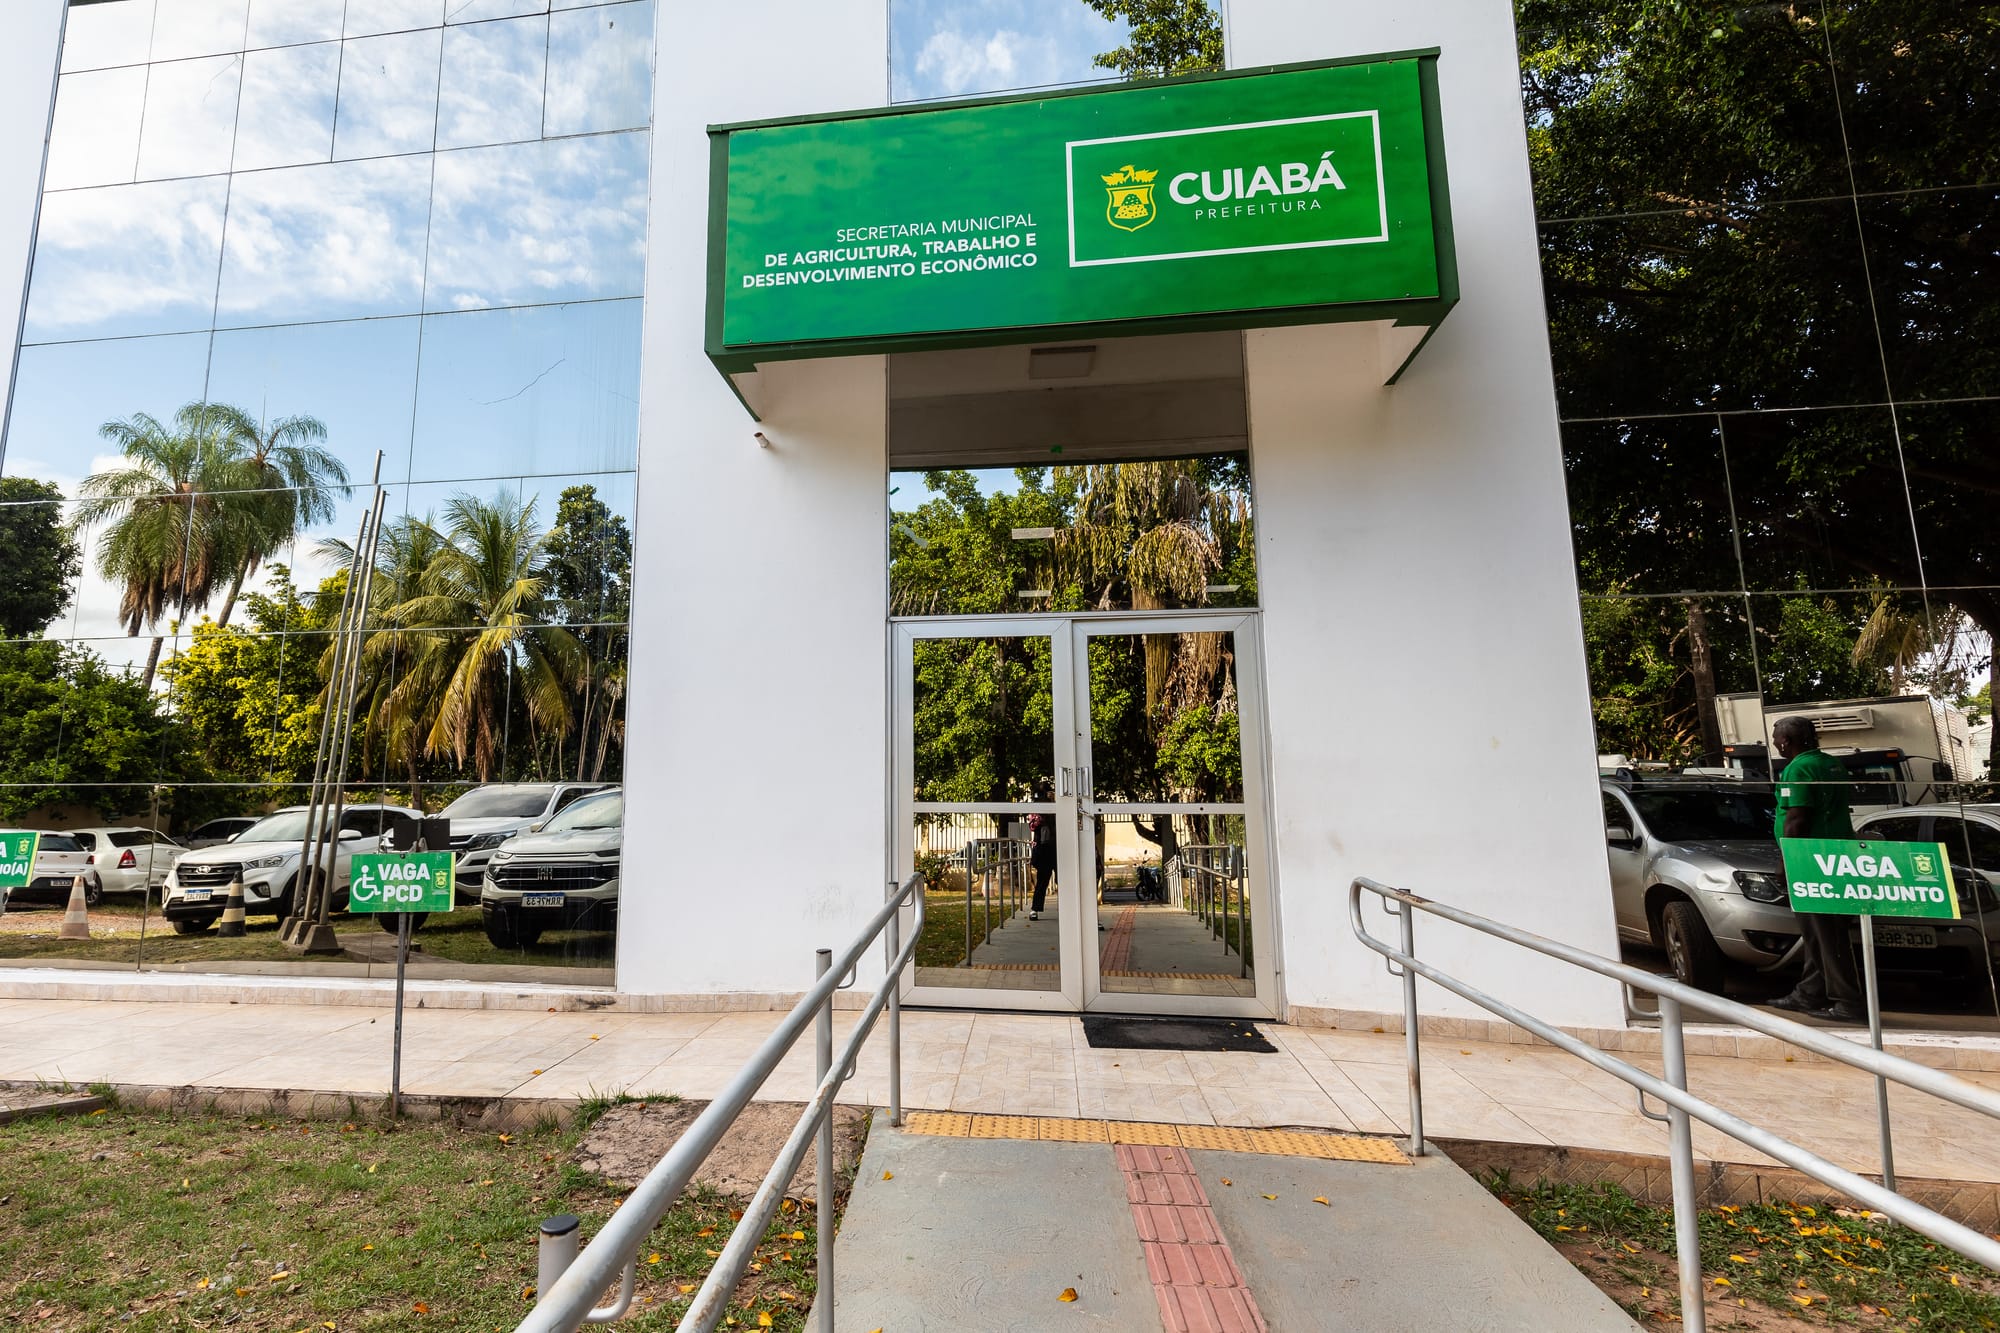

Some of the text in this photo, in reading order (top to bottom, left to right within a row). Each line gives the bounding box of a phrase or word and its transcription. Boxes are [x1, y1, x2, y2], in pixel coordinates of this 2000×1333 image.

[1169, 150, 1346, 205] CUIABÁ
[1195, 199, 1321, 220] PREFEITURA
[836, 213, 1037, 243] SECRETARIA MUNICIPAL
[765, 232, 1037, 268] DE AGRICULTURA, TRABALHO E
[742, 253, 1038, 288] DESENVOLVIMENTO ECONÔMICO
[378, 862, 430, 881] VAGA
[1813, 853, 1902, 879] VAGA
[382, 885, 423, 903] PCD
[1792, 881, 1945, 903] SEC. ADJUNTO
